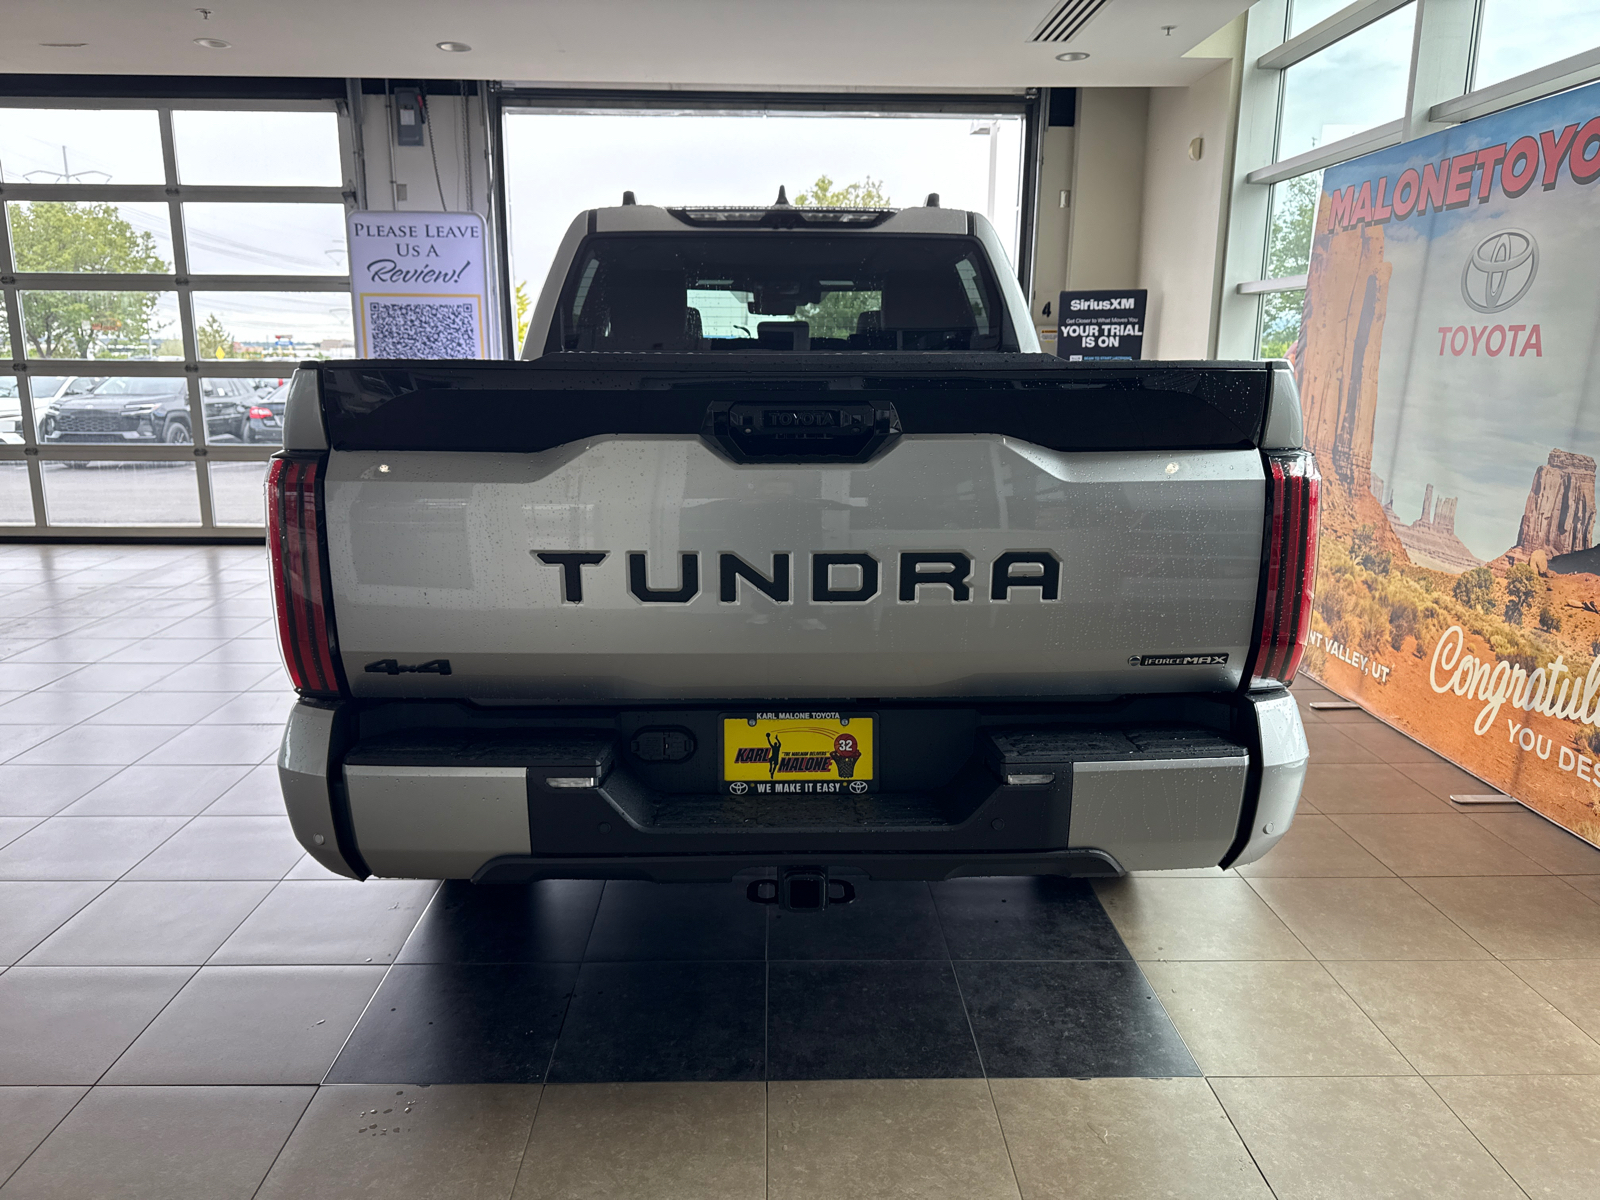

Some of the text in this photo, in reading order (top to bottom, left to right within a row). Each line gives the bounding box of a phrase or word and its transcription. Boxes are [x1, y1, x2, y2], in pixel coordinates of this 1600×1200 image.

[354, 223, 479, 239] PLEASE LEAVE
[395, 243, 440, 257] US A
[366, 258, 471, 284] Review!
[1042, 301, 1051, 318] 4
[1070, 298, 1135, 311] SiriusXM
[1061, 325, 1099, 337] YOUR
[1101, 324, 1143, 336] TRIAL
[1081, 336, 1119, 348] IS ON
[1437, 324, 1543, 358] TOYOTA
[769, 412, 836, 426] TOYOTA
[529, 549, 1064, 605] TUNDRA
[1325, 637, 1369, 676] VALLEY,
[1372, 661, 1390, 683] UT
[1430, 625, 1600, 736] Congratul
[838, 739, 853, 751] 32
[1508, 719, 1552, 760] YOU
[734, 747, 772, 764] KARL
[777, 756, 833, 773] MALONE
[757, 782, 840, 793] WE MAKE IT EASY
